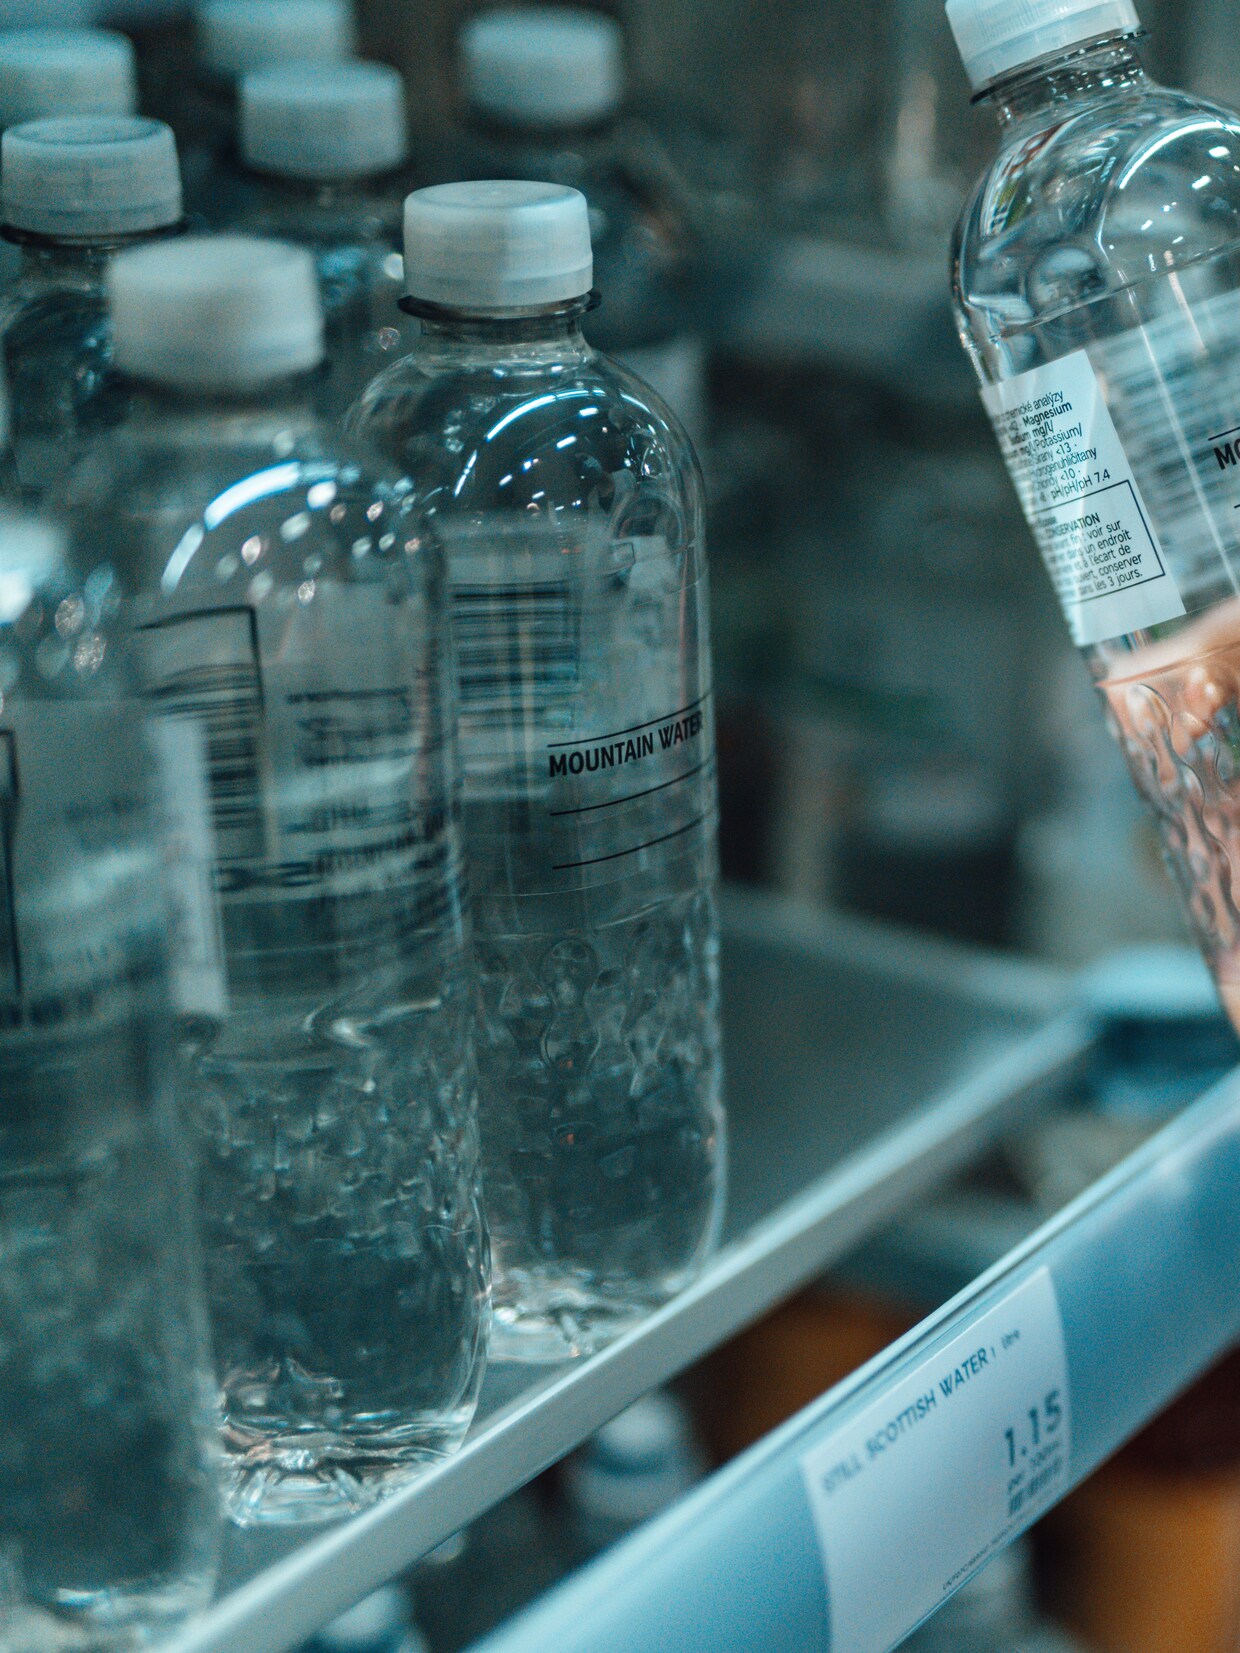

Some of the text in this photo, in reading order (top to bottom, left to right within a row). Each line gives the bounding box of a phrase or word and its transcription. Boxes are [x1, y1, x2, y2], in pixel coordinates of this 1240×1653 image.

[1033, 390, 1064, 410] analýzy
[1022, 401, 1073, 427] Magnesium
[1056, 440, 1072, 455] <13
[1051, 475, 1092, 501] pH/pH/pH
[1094, 468, 1111, 484] 7.4
[1060, 469, 1076, 482] <10
[1084, 543, 1096, 554] un
[1098, 529, 1132, 551] endroit
[1086, 524, 1104, 539] voir
[1106, 519, 1121, 533] sur
[1088, 547, 1115, 566] l'écart
[1118, 543, 1131, 556] de
[1099, 553, 1143, 577] conserver
[1094, 578, 1107, 591] les
[1108, 575, 1115, 587] 3
[1115, 566, 1143, 587] jours.
[549, 711, 703, 778] MOUNTAIN WATER
[821, 1456, 862, 1495] STILL
[865, 1390, 937, 1462] SCOTTISH
[939, 1347, 989, 1398] WATER
[1005, 1388, 1063, 1468] 1.15
